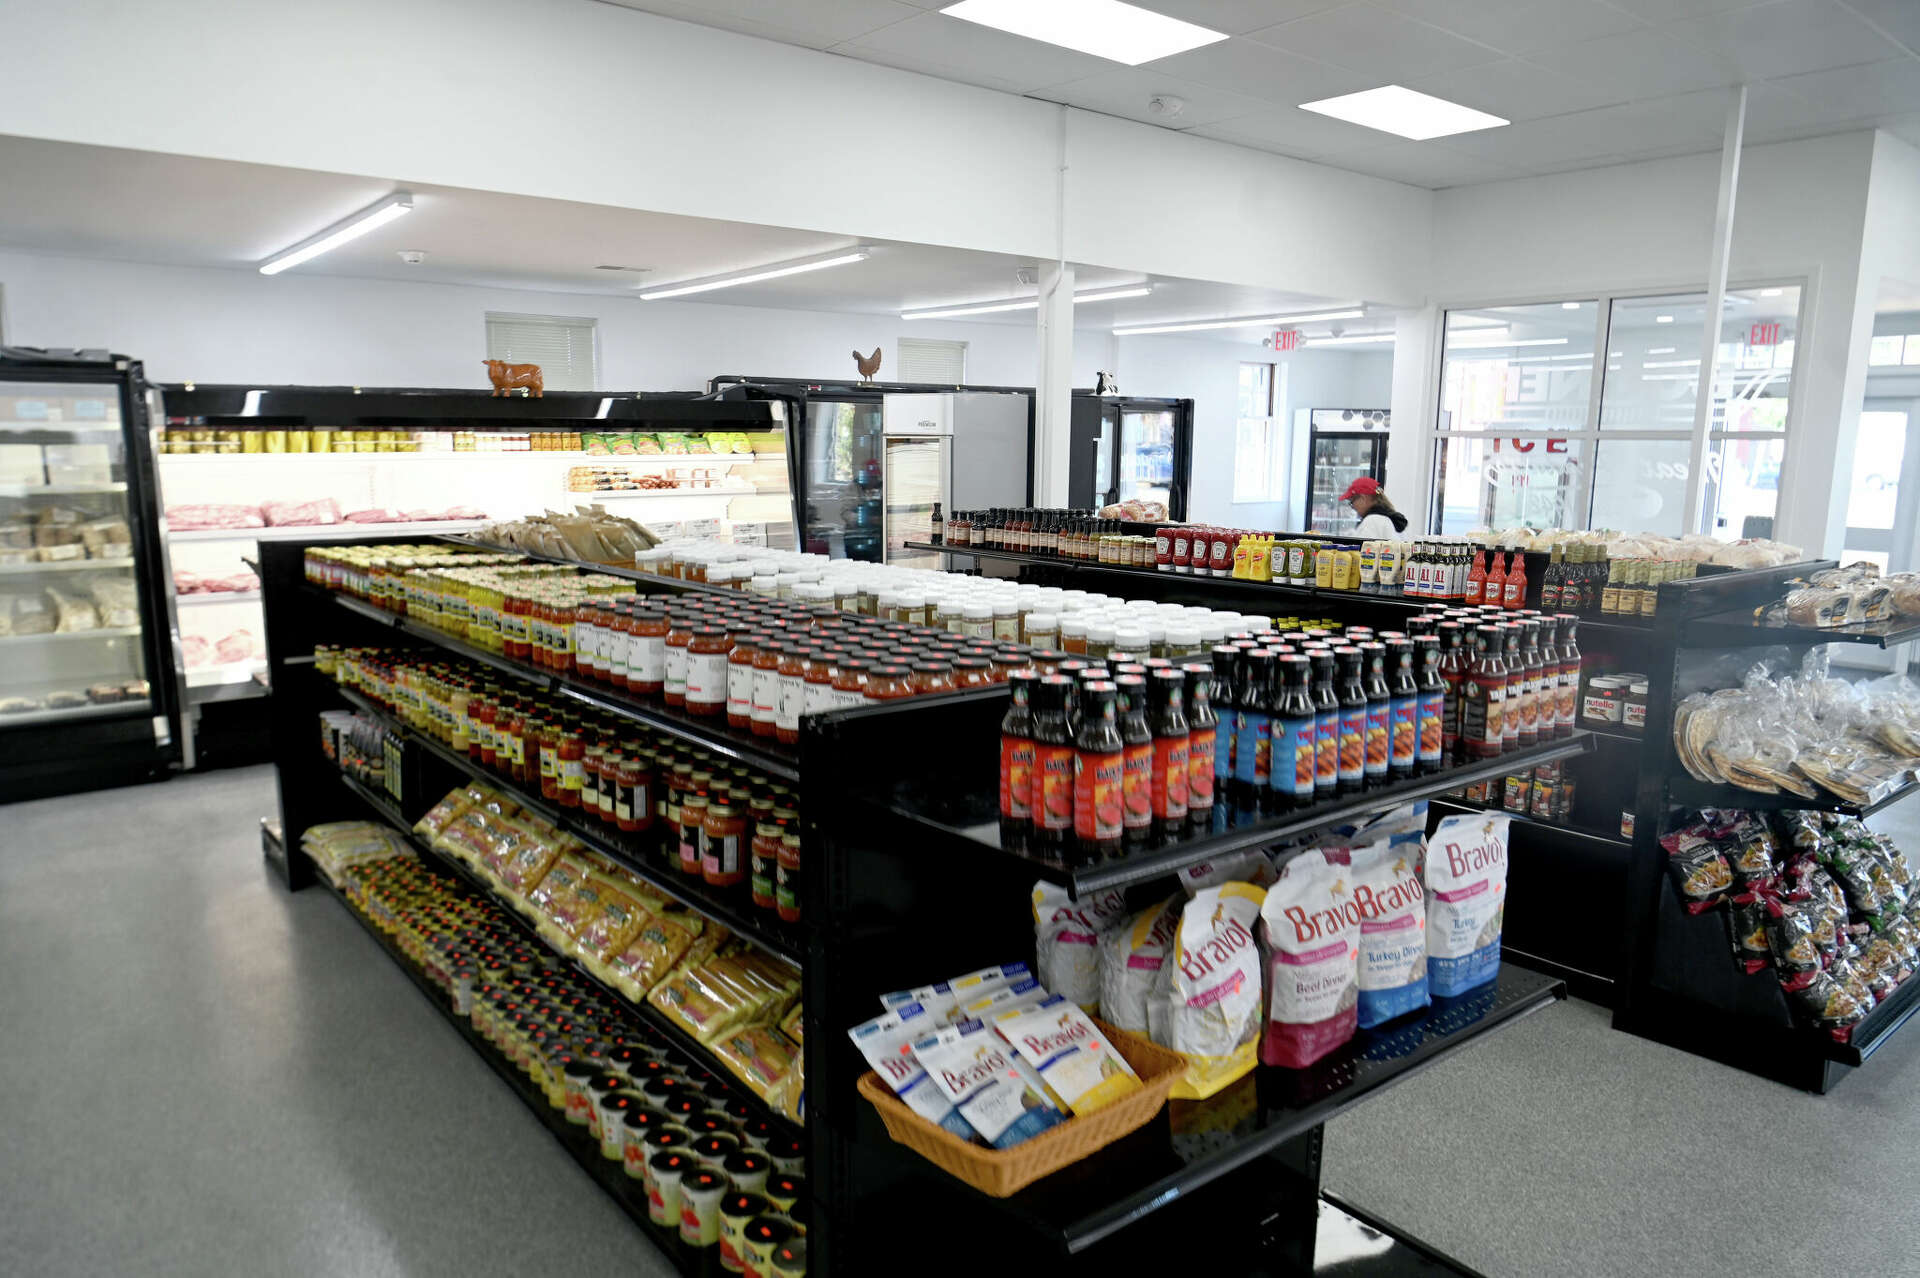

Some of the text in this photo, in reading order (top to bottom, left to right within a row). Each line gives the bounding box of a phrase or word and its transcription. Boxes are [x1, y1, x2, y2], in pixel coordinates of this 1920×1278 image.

[1275, 330, 1297, 351] EXIT
[1751, 323, 1781, 345] EXIT
[1586, 699, 1615, 710] nutella
[1627, 706, 1647, 715] nute
[1445, 837, 1505, 878] Bravo!
[1354, 878, 1423, 919] Bravo
[1284, 901, 1361, 943] Bravo
[1296, 978, 1320, 994] Beef
